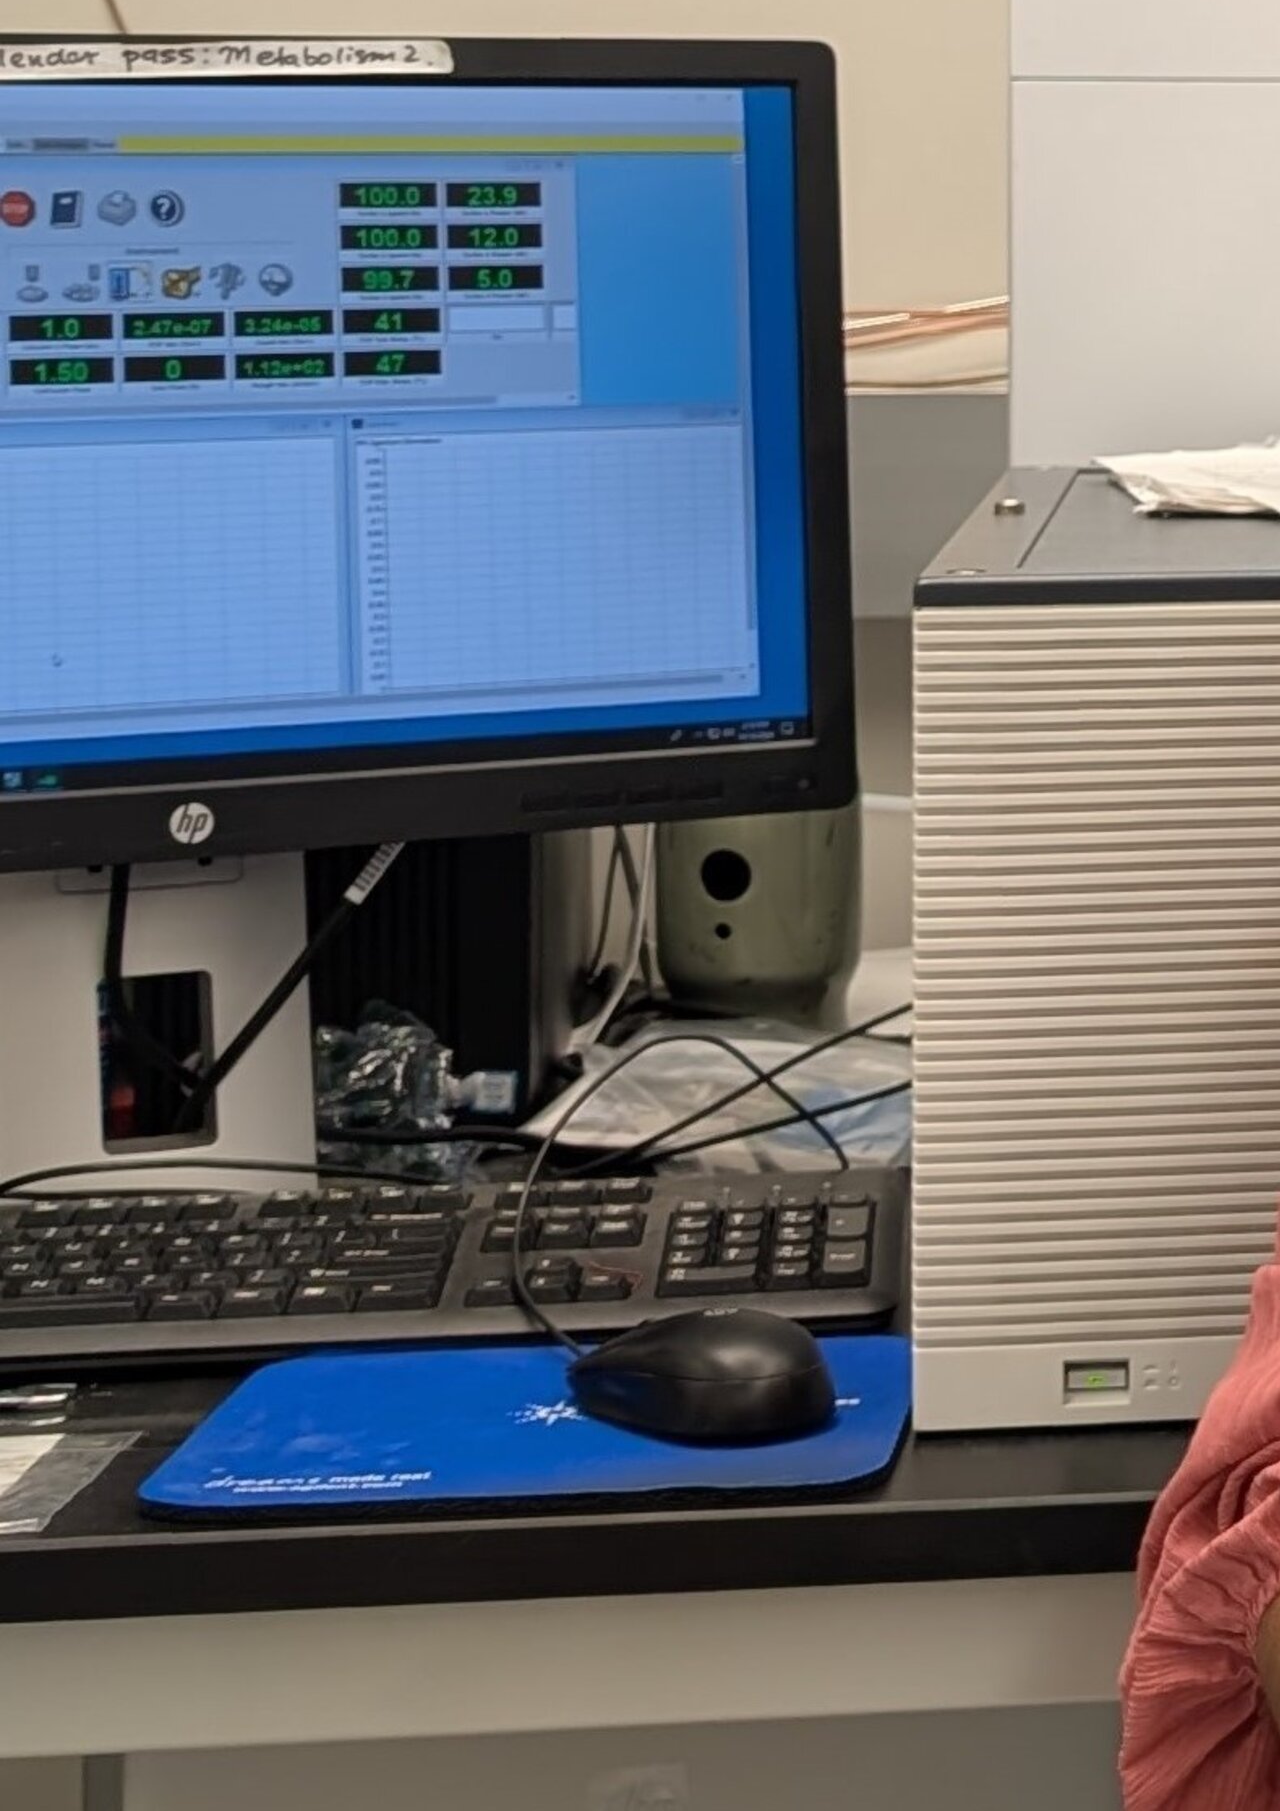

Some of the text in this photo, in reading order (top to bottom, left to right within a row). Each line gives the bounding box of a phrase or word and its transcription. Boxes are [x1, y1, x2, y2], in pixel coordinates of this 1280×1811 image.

[355, 186, 421, 205] 100.0
[467, 186, 518, 205] 23.9
[356, 228, 422, 248] 100.0
[469, 227, 519, 247] 12.0
[363, 270, 415, 289] 99.7
[477, 269, 513, 288] 5.0
[41, 318, 79, 338] 1.0
[374, 312, 402, 330] 41
[34, 361, 88, 382] 1.50
[165, 359, 182, 379] 0
[376, 354, 405, 373] 47
